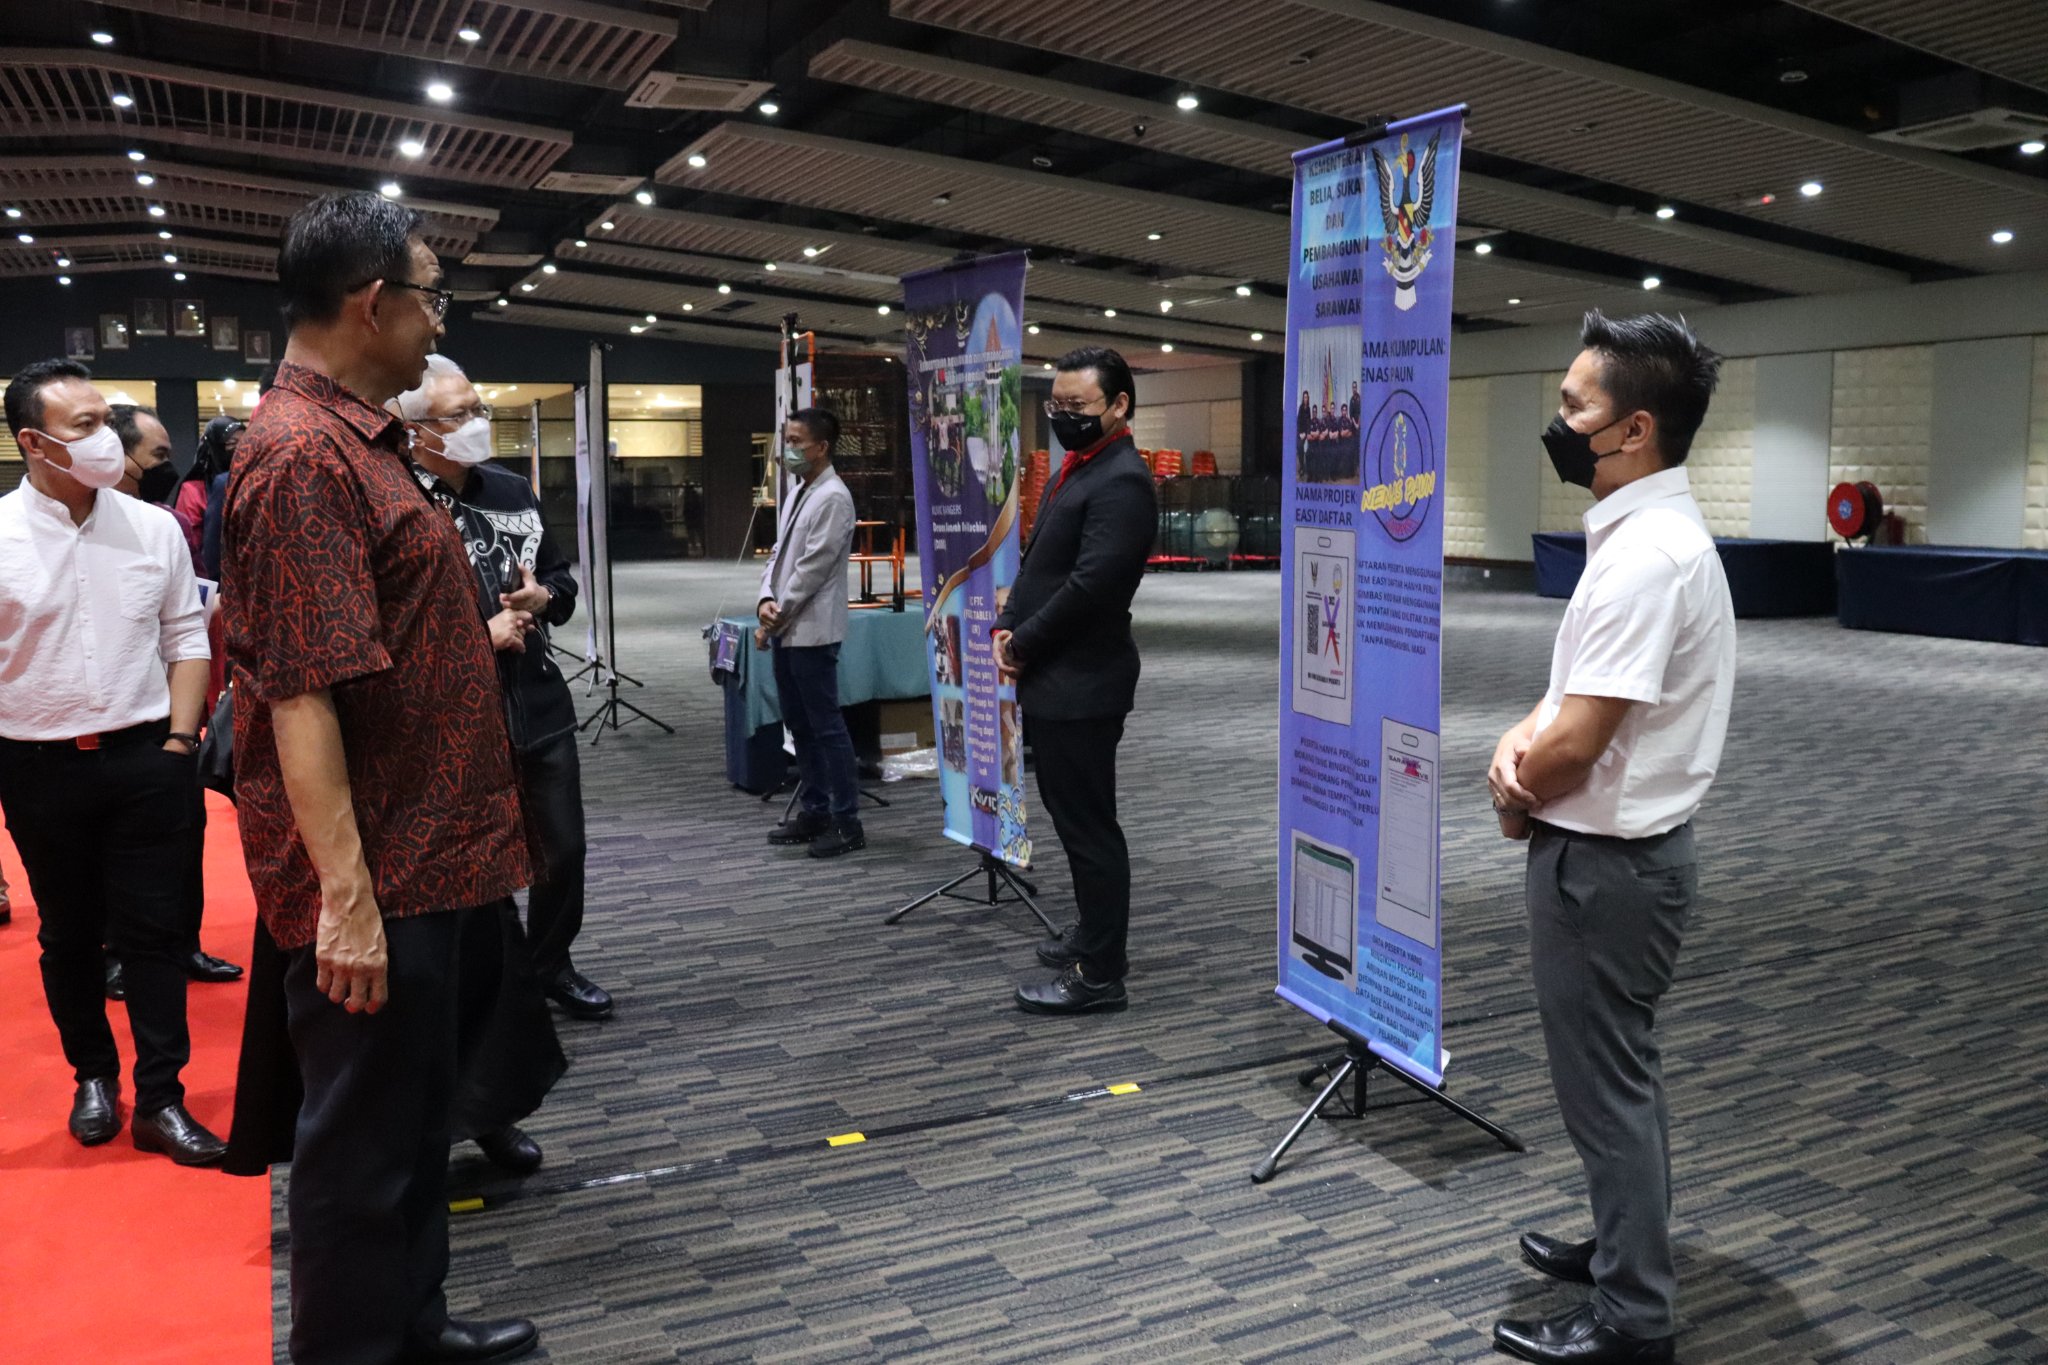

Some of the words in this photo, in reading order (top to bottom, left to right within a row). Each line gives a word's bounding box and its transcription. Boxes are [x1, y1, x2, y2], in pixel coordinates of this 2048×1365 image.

[1336, 178, 1362, 199] SUKA
[1326, 212, 1344, 230] DAN
[1315, 298, 1362, 318] SARAWAK
[1362, 341, 1389, 358] AMA
[1361, 366, 1389, 383] ENAS
[1391, 366, 1414, 382] PAUN
[1296, 487, 1323, 502] NAMA
[1296, 508, 1318, 523] EASY
[1319, 509, 1353, 526] DAFTAR
[1372, 576, 1386, 586] EASY
[1361, 634, 1384, 646] TANPA
[1384, 940, 1407, 959] PESERTA
[1397, 961, 1424, 983] PROGRAM
[1355, 986, 1370, 1000] DATA
[1383, 999, 1395, 1013] DAN
[1395, 1005, 1415, 1024] MUDAH
[1383, 984, 1407, 1005] SELAMAT
[1413, 1000, 1433, 1018] DALAM
[1378, 1027, 1409, 1051] PELAPORAN
